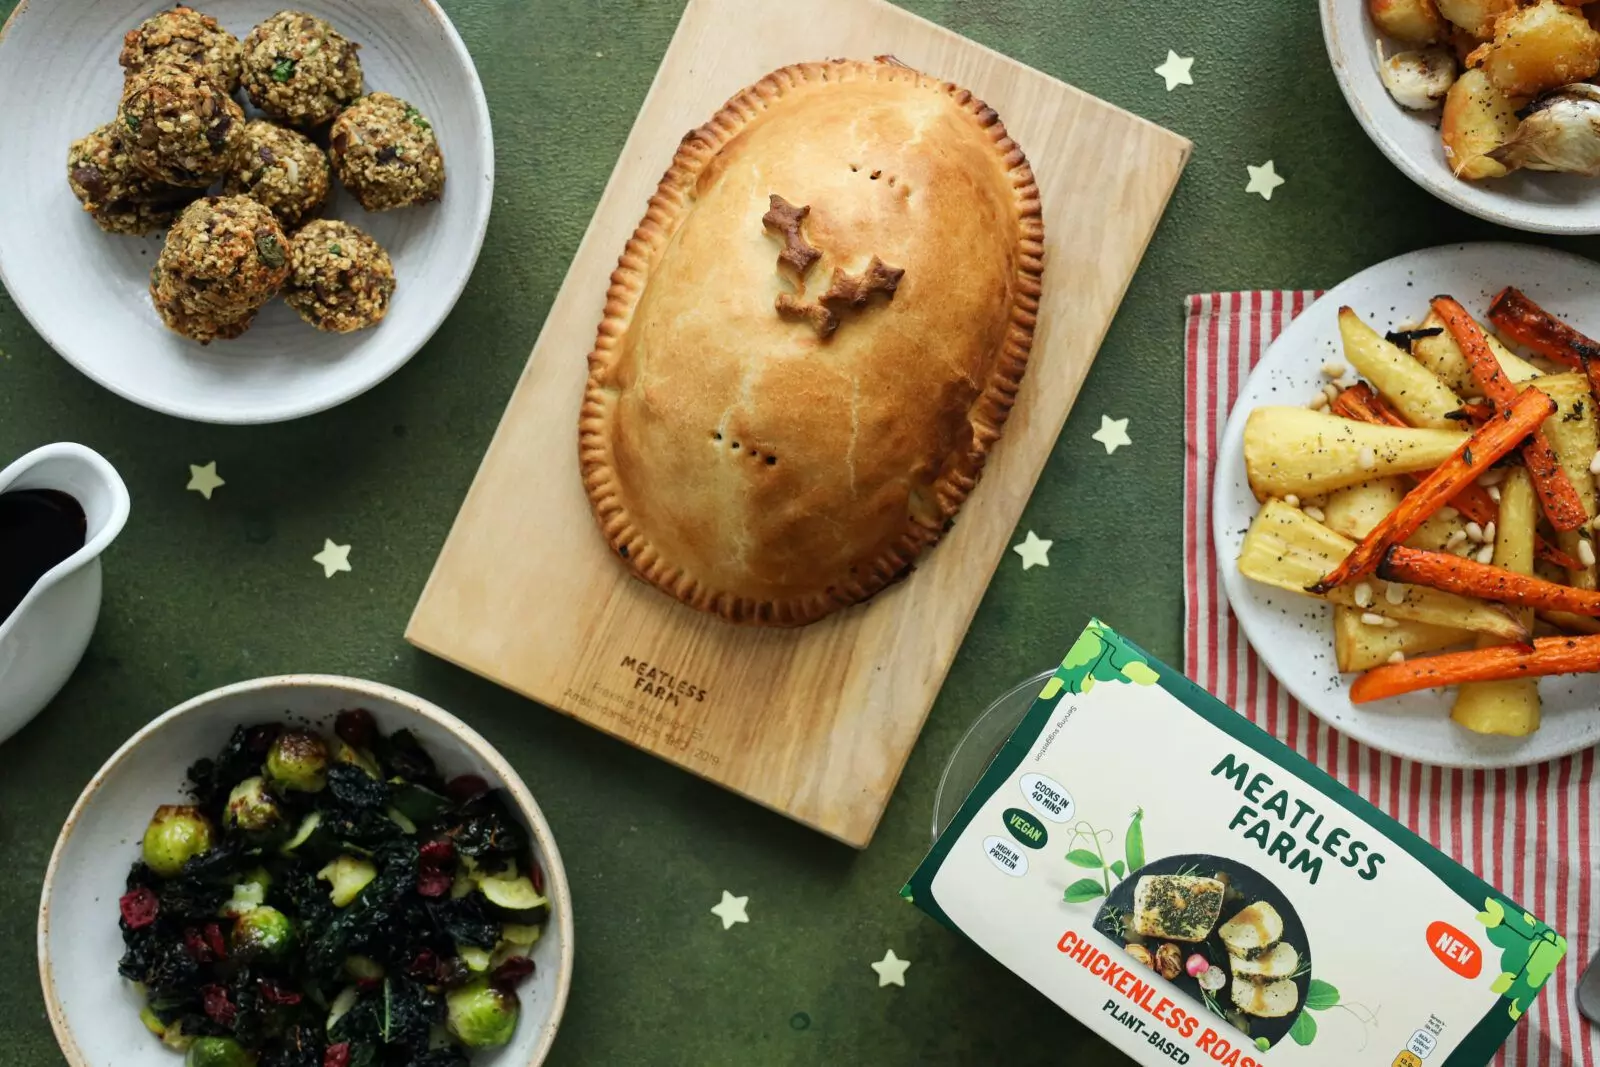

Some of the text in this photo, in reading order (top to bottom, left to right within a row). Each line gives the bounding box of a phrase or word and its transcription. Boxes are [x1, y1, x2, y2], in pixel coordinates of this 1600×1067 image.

[620, 655, 707, 702] MEATLESS
[633, 677, 680, 707] FARM
[1035, 705, 1078, 761] Serving suggestion
[1031, 790, 1062, 815] 40 MINS
[1034, 780, 1070, 809] COOKS IN
[1009, 813, 1043, 843] VEGAN
[1210, 753, 1386, 882] MEATLESS
[989, 847, 1017, 870] PROTEIN
[995, 841, 1020, 862] HIGH IN
[1229, 805, 1324, 885] FARM
[1435, 931, 1476, 965] NEW
[1056, 930, 1267, 1067] CHICKENLESS ROAS
[1102, 998, 1191, 1066] PLANT-BASED
